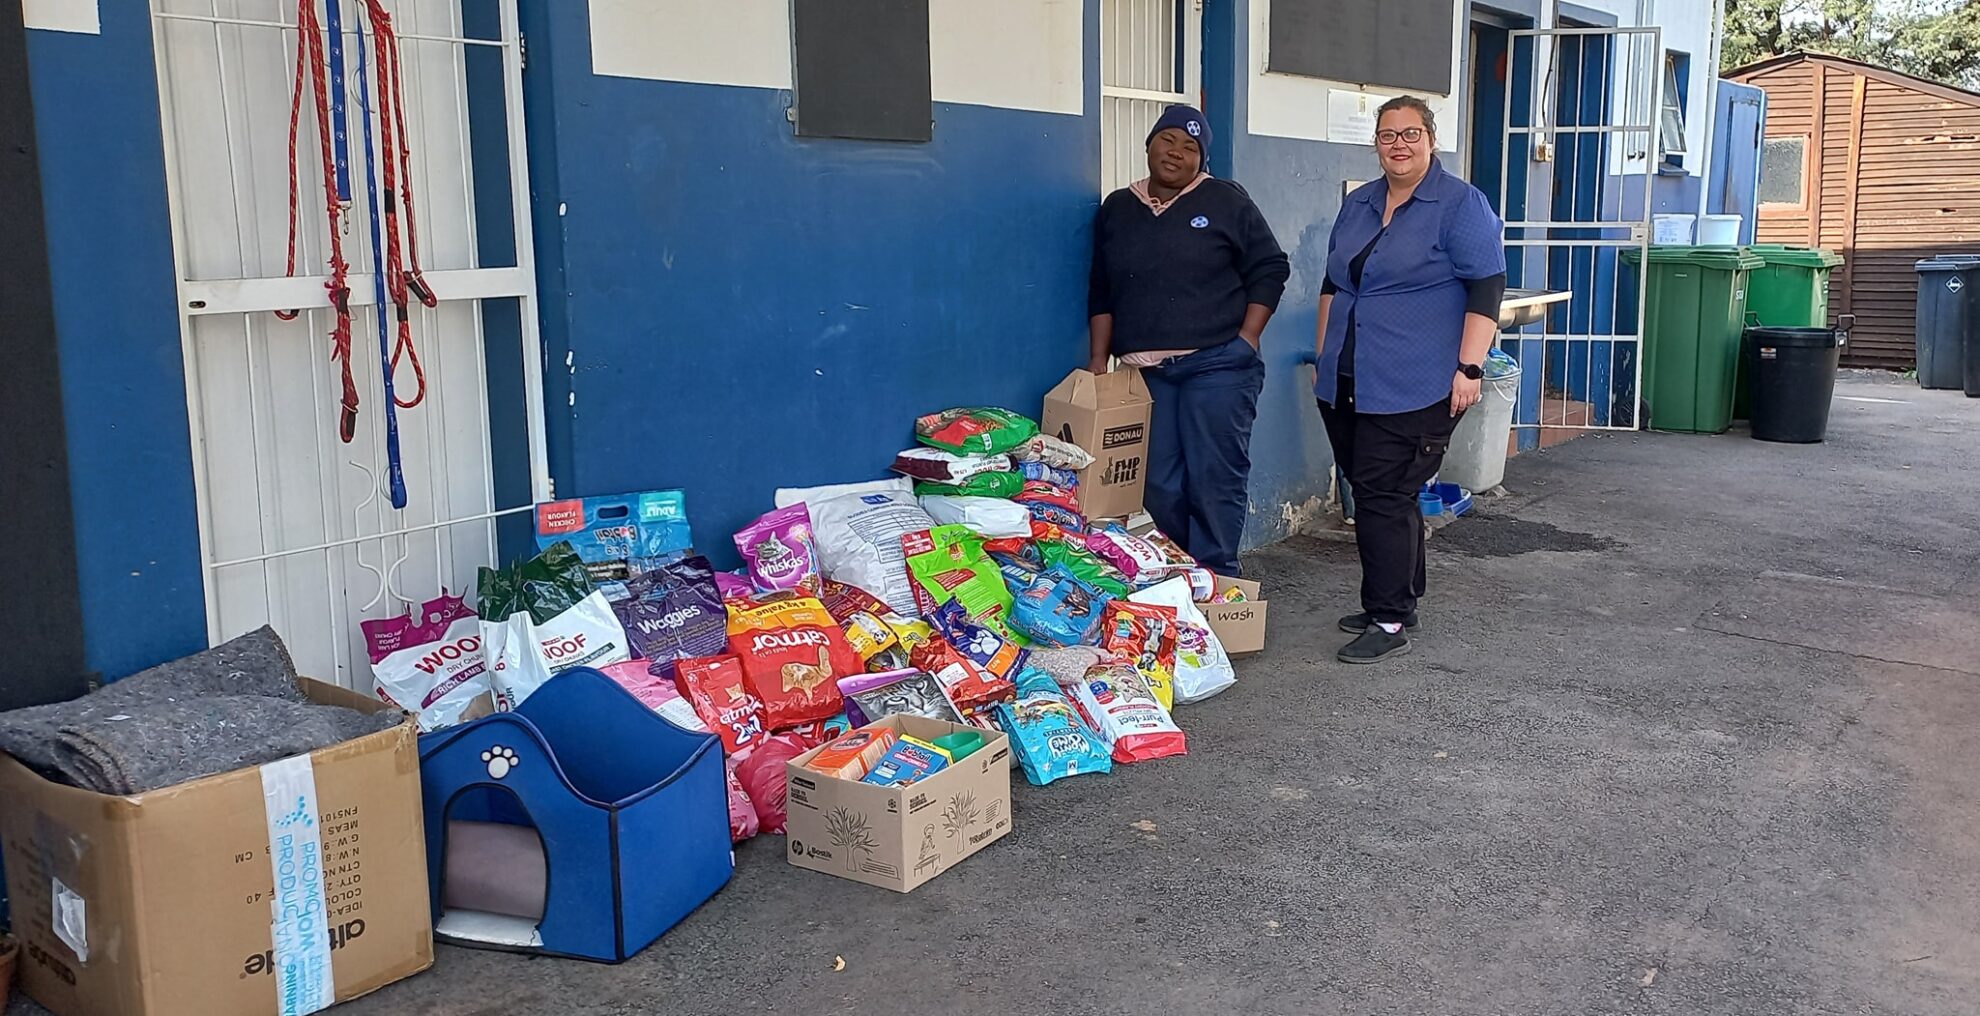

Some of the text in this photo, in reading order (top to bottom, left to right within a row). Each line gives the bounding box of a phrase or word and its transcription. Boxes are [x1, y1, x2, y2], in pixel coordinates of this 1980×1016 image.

[1114, 429, 1142, 442] DONAU
[1115, 456, 1141, 473] FLIP
[1113, 468, 1139, 484] FILE
[646, 504, 677, 517] ADULT
[548, 518, 575, 528] CHICKEN
[757, 556, 804, 577] whiskas
[756, 604, 784, 618] Value
[1218, 608, 1254, 622] wash
[637, 604, 701, 634] Waggies
[752, 630, 831, 655] catmor
[415, 634, 481, 674] WOO
[447, 661, 463, 673] DRY
[438, 667, 482, 694] RICH LAMB
[235, 851, 253, 864] CM
[339, 860, 361, 875] CTN
[247, 892, 261, 905] 40
